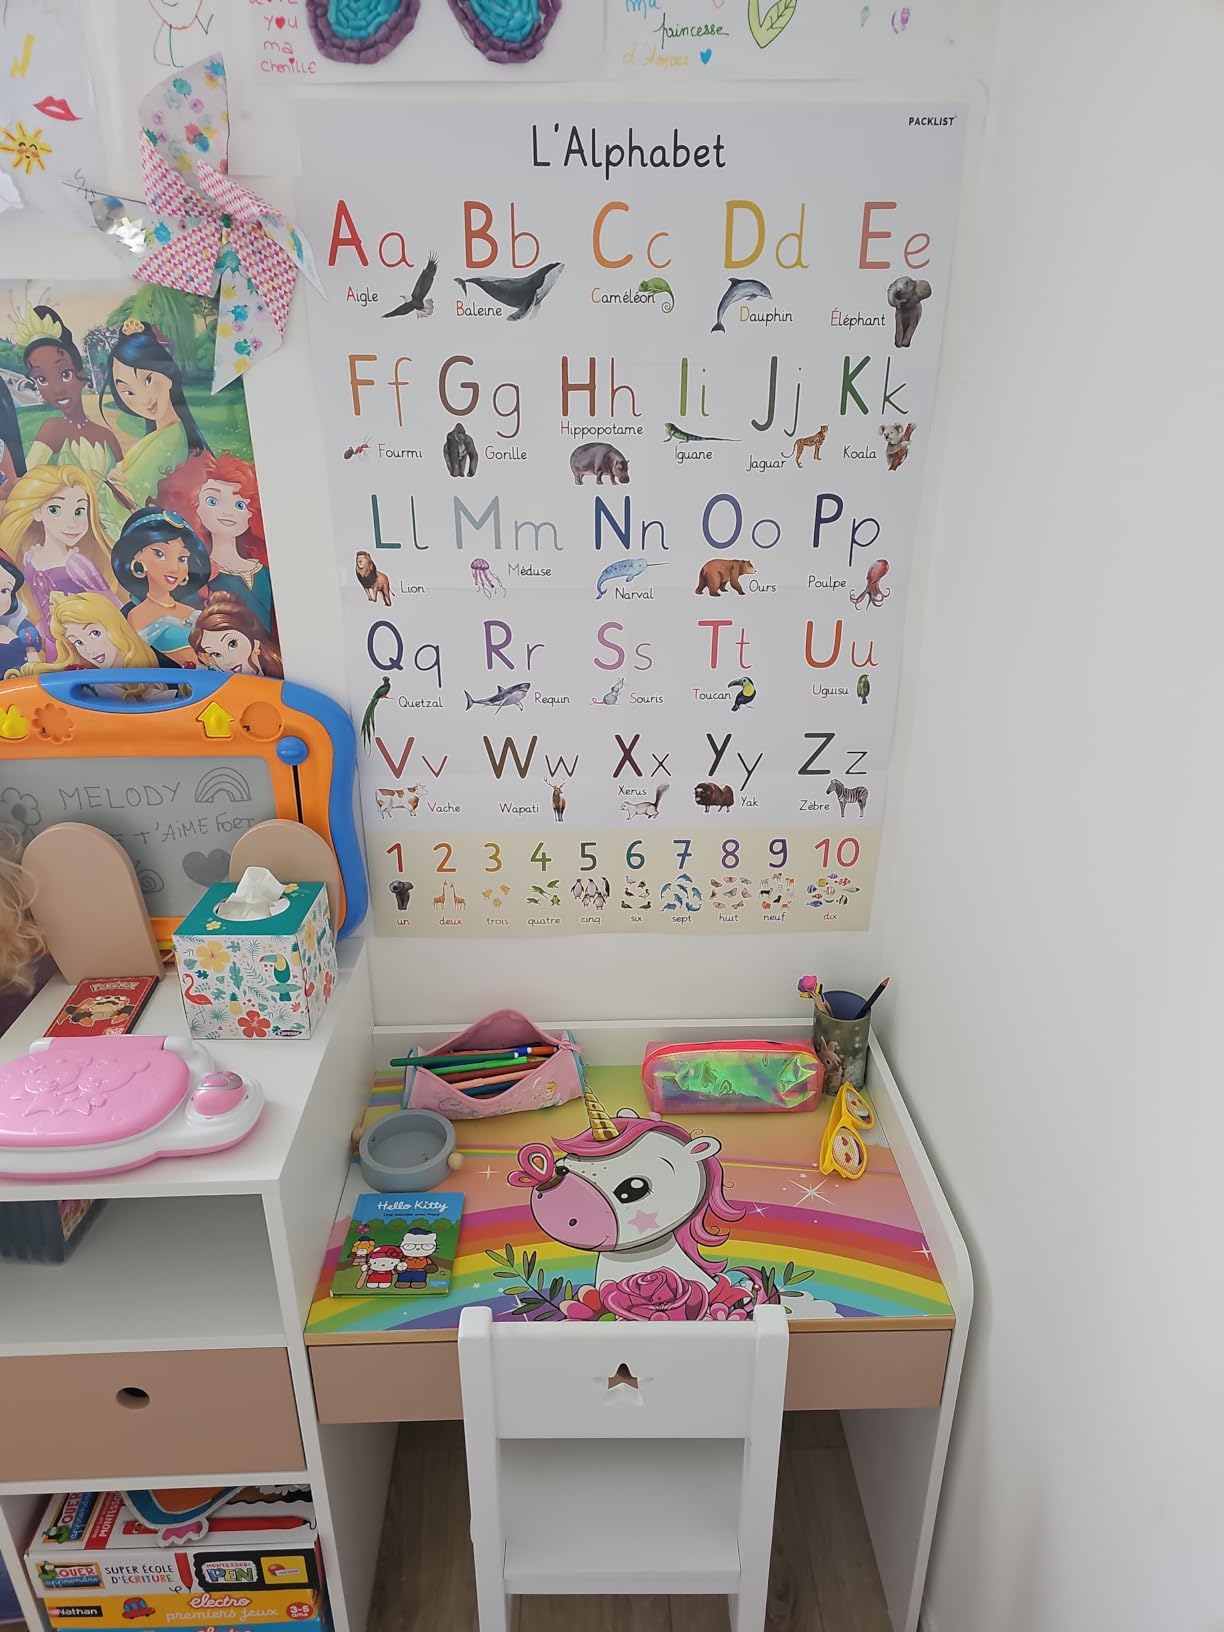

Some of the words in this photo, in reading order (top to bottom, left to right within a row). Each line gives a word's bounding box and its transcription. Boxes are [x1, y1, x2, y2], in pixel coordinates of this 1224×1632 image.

[652, 12, 729, 50] princesse
[263, 40, 294, 55] ma
[908, 116, 955, 126] PACKLIST
[532, 122, 726, 181] L'Alphabet
[346, 286, 379, 307] Aigle
[591, 287, 656, 304] Caméléon
[455, 301, 503, 317] Baleine
[739, 306, 794, 327] Dauphin
[830, 308, 886, 331] Éléphant
[560, 419, 644, 438] Hippopotame
[378, 443, 423, 459] Fourmi
[485, 446, 528, 461] Gorille
[674, 446, 713, 463] Iguane
[843, 445, 877, 460] Koala
[746, 455, 787, 473] Jaguar
[508, 562, 552, 577] Méduse
[400, 580, 426, 594] Lion
[749, 579, 777, 593] Ours
[808, 574, 847, 592] Poulpe
[614, 587, 655, 600] Narval
[630, 692, 664, 705] Souris
[692, 688, 732, 701] Toucan
[812, 683, 850, 699] Uguisu
[398, 695, 444, 709] Quetzal
[534, 692, 571, 706] Requin
[58, 782, 181, 810] MELODY
[618, 784, 648, 797] Xerus
[427, 802, 461, 814] Vache
[499, 802, 540, 817] Wapati
[740, 796, 760, 808] Yak
[799, 798, 830, 811] Zèbre
[386, 842, 404, 873] 1
[433, 842, 457, 873] 2
[484, 842, 502, 872] 3
[530, 841, 552, 871] 4
[580, 842, 597, 871] 5
[626, 839, 646, 870] 6
[673, 839, 693, 870] 7
[721, 838, 740, 870] 8
[769, 838, 788, 868] 9
[814, 837, 861, 869] 10
[396, 918, 410, 926] un
[439, 916, 464, 926] deux
[486, 916, 510, 926] trois
[528, 917, 561, 927] quatre
[580, 915, 602, 925] cinq
[630, 914, 643, 923] six
[671, 914, 693, 924] sept
[718, 913, 740, 923] huit
[763, 911, 787, 923] neuf
[823, 911, 838, 921] dix
[377, 1200, 412, 1211] Hello
[414, 1199, 449, 1213] Kitty
[105, 1566, 139, 1575] SUPER
[142, 1564, 174, 1574] ÉCOLE
[207, 1568, 254, 1582] PEN
[111, 1574, 172, 1584] D'ÉCRITURE
[190, 1593, 251, 1608] electro
[56, 1608, 98, 1616] Nathan
[166, 1610, 236, 1621] premiers
[240, 1607, 279, 1622] jeux
[289, 1604, 310, 1613] 3-5
